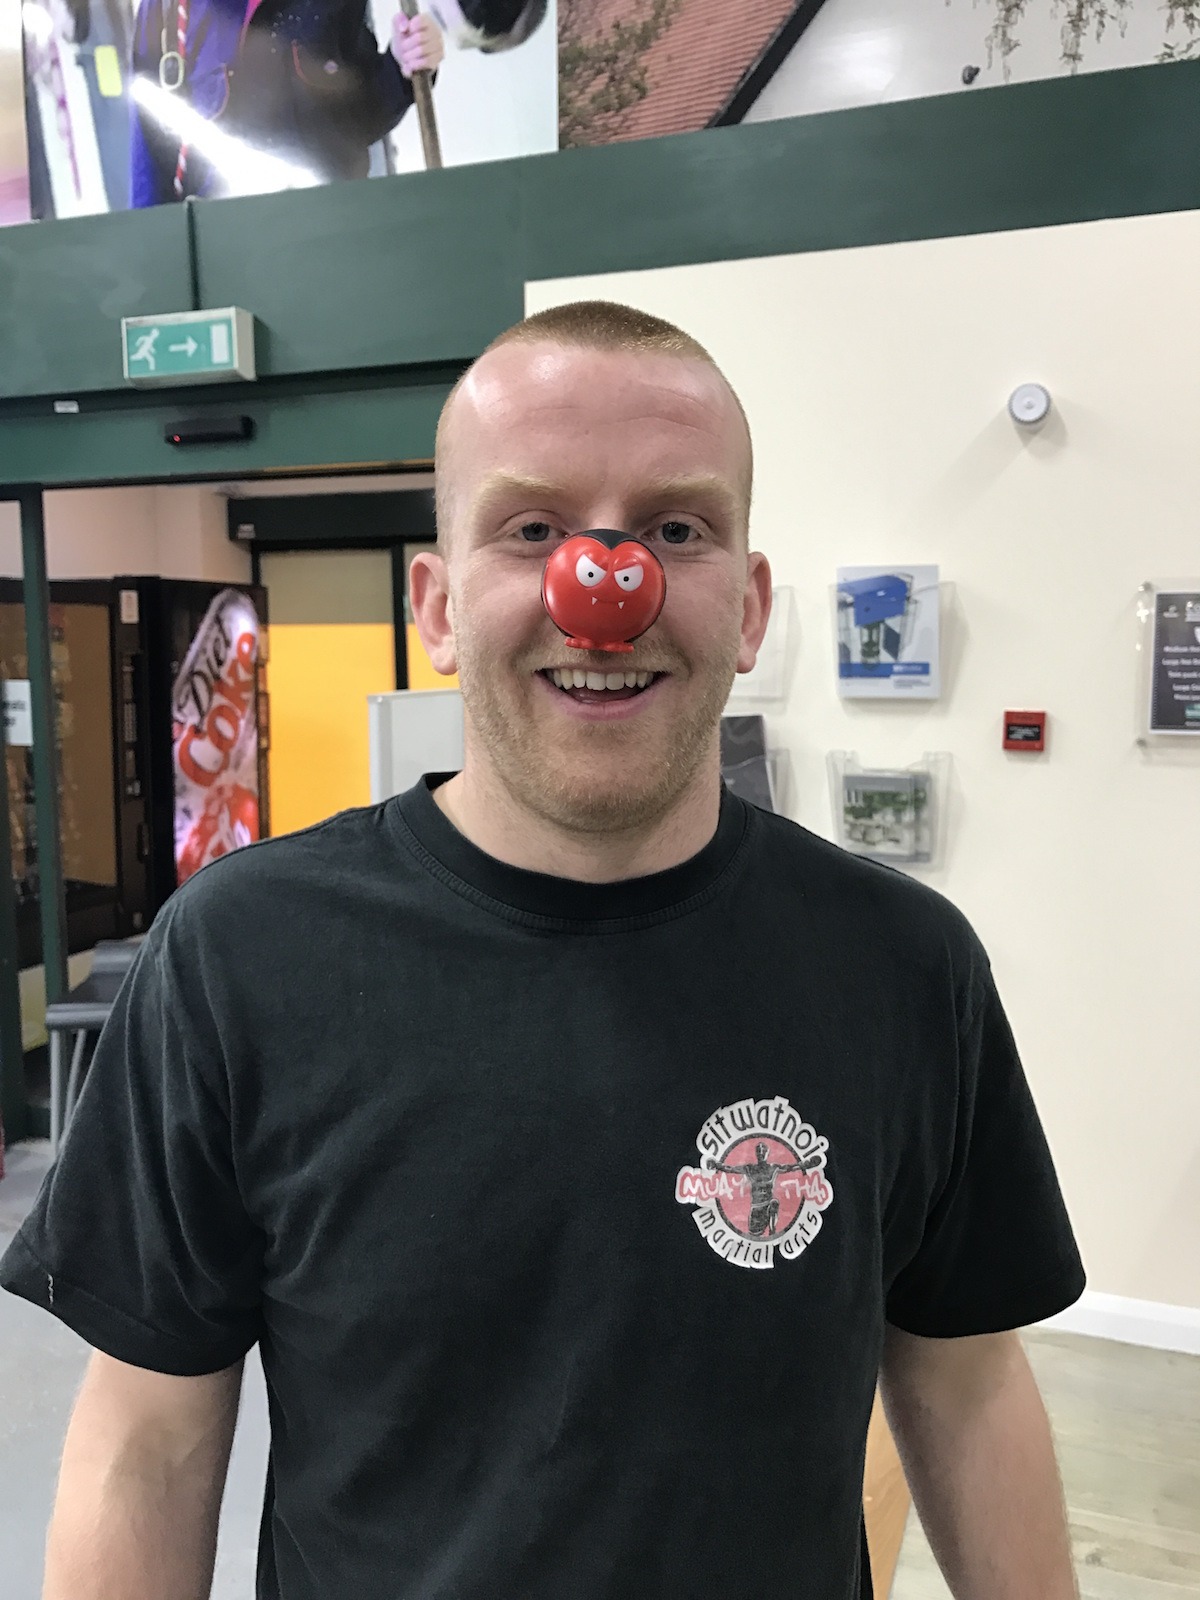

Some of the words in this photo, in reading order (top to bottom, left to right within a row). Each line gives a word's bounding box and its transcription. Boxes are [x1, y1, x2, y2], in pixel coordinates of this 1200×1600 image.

[176, 612, 230, 734] Diet
[179, 633, 256, 786] Coke
[681, 1172, 751, 1200] MUAY
[700, 1209, 769, 1263] martial
[784, 1211, 818, 1254] arts
